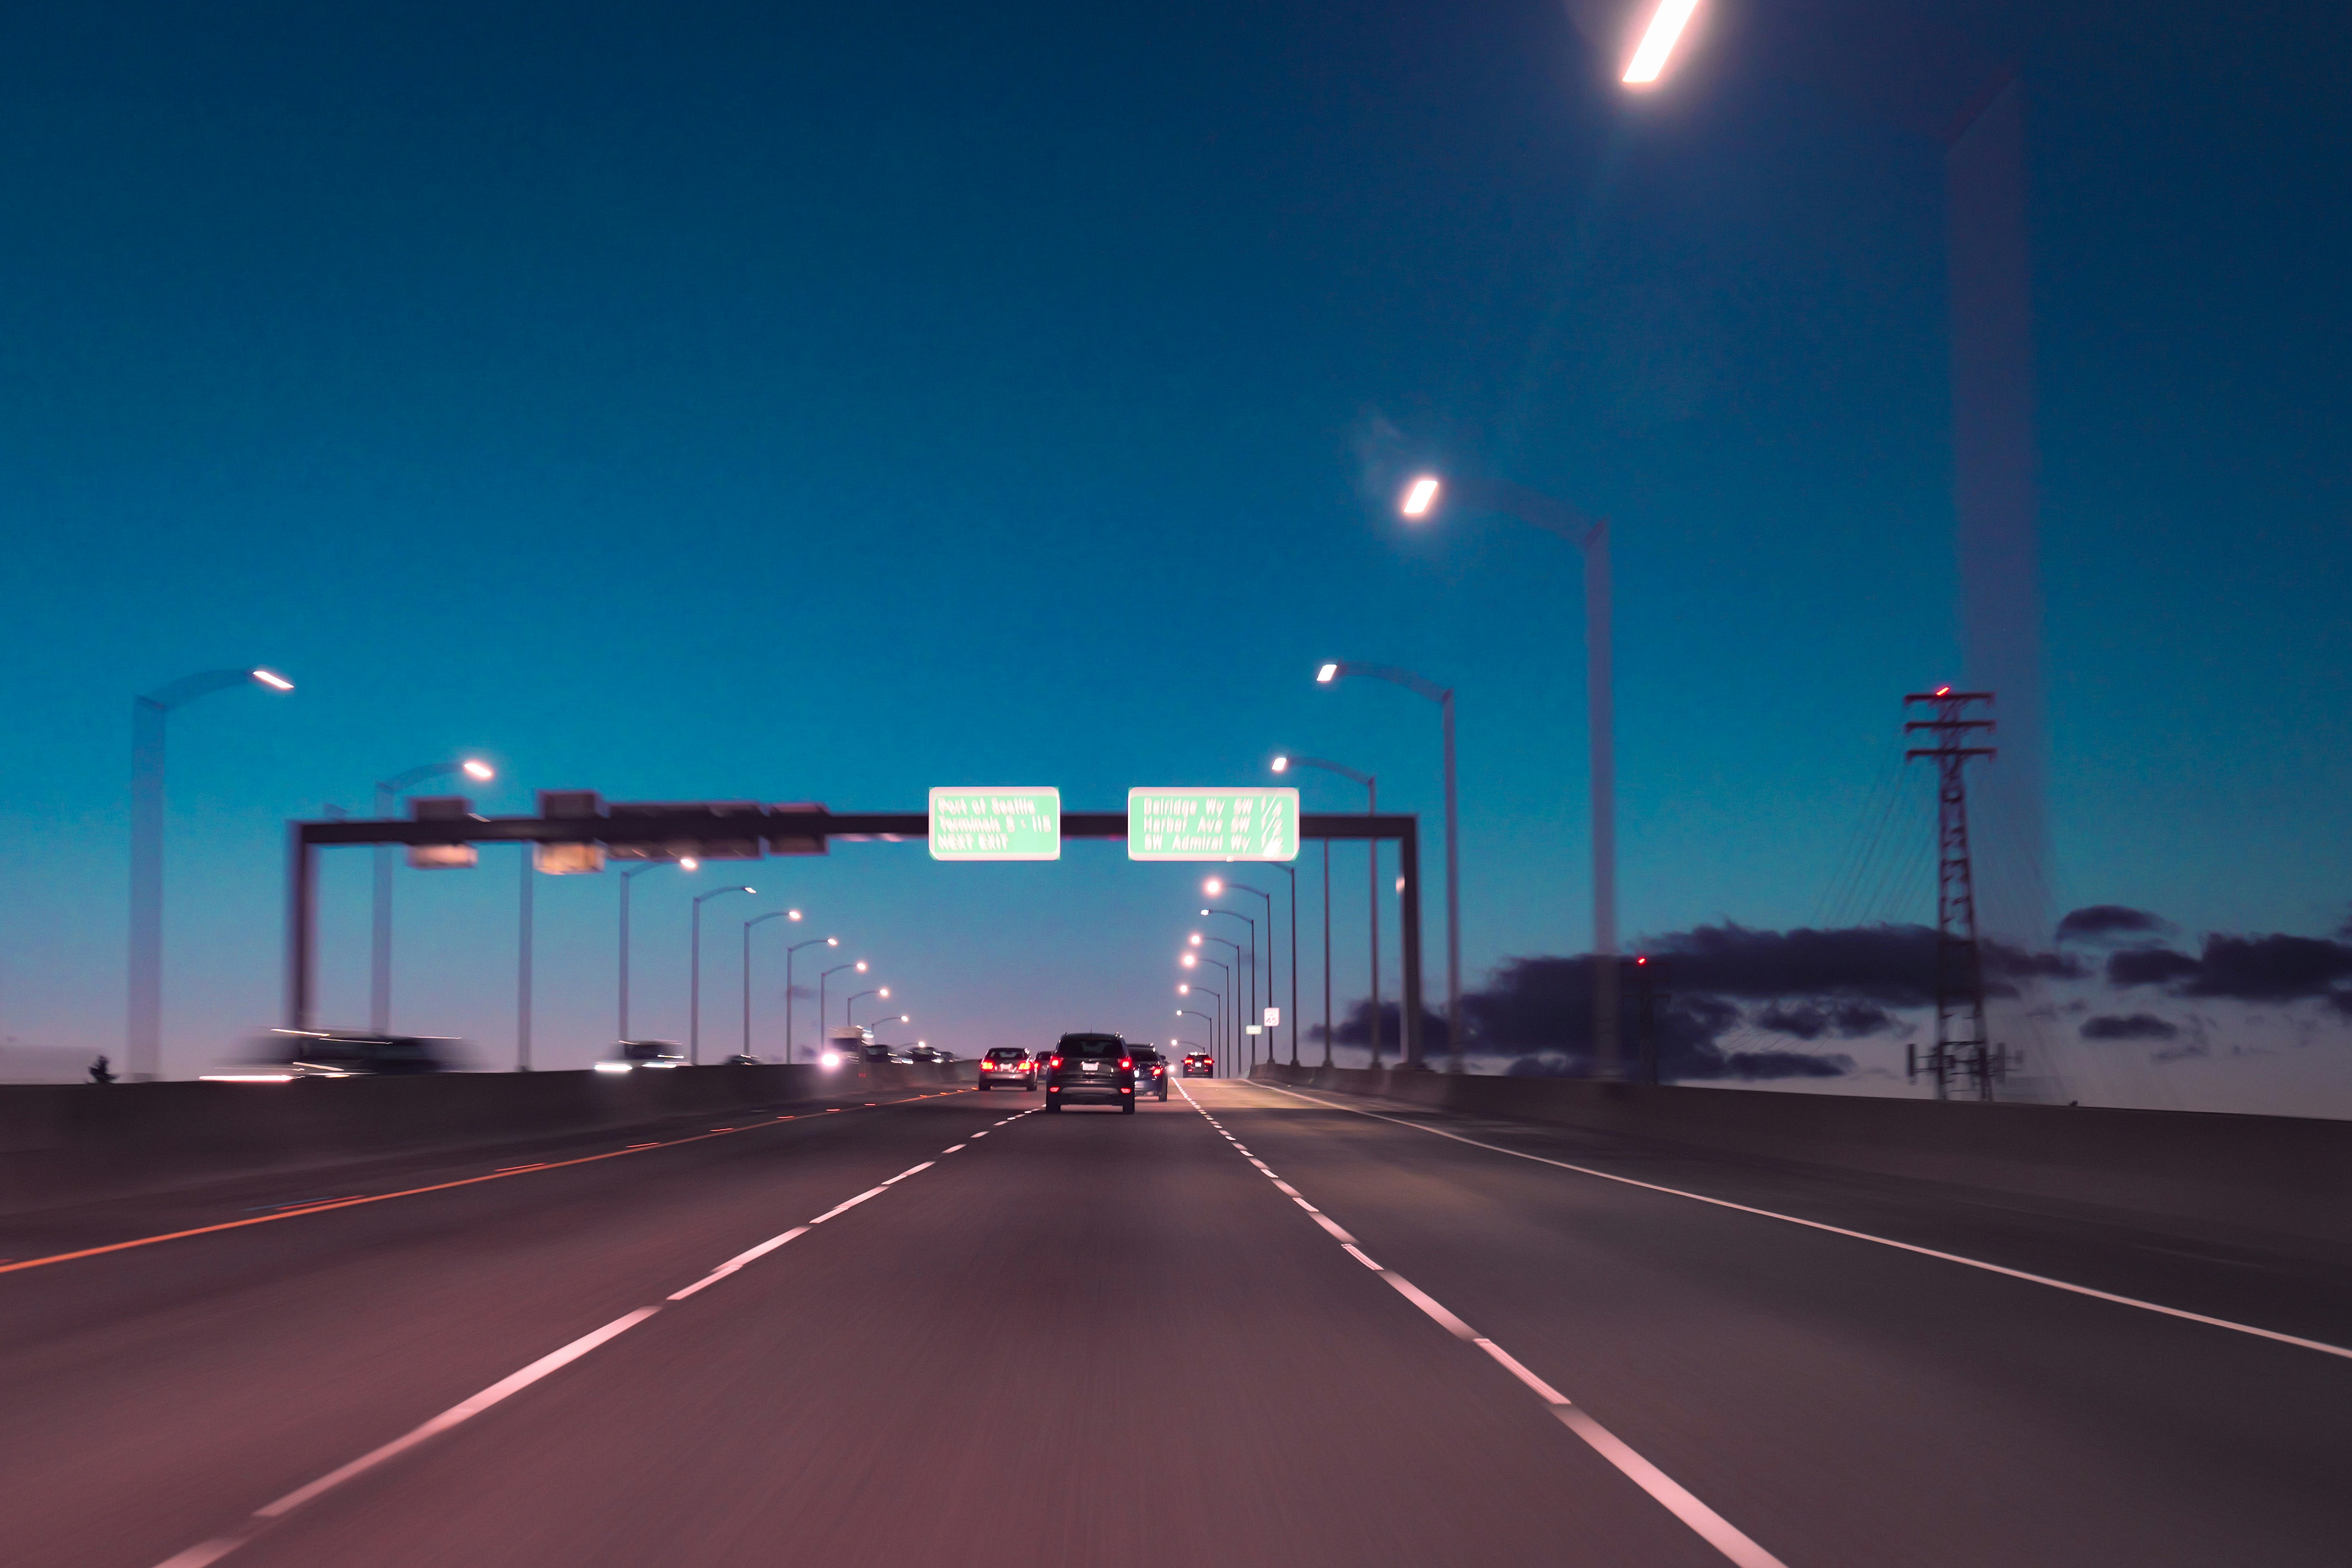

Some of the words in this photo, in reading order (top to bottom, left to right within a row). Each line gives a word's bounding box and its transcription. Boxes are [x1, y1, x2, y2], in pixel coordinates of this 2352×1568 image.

[938, 797, 967, 815] Port
[971, 797, 986, 815] of
[991, 797, 1036, 816] Seattle
[1144, 797, 1197, 818] Delridge
[1205, 797, 1225, 818] Wy
[1234, 797, 1253, 815] SW
[938, 815, 1001, 833] Terminals
[1144, 815, 1188, 833] Harbor
[1197, 815, 1223, 833] Ave
[1230, 815, 1251, 833] SW
[938, 832, 974, 851] NEXT
[979, 832, 1009, 851] EXIT
[1144, 833, 1162, 851] SW
[1172, 833, 1223, 851] Admiral
[1231, 834, 1251, 853] Wy
